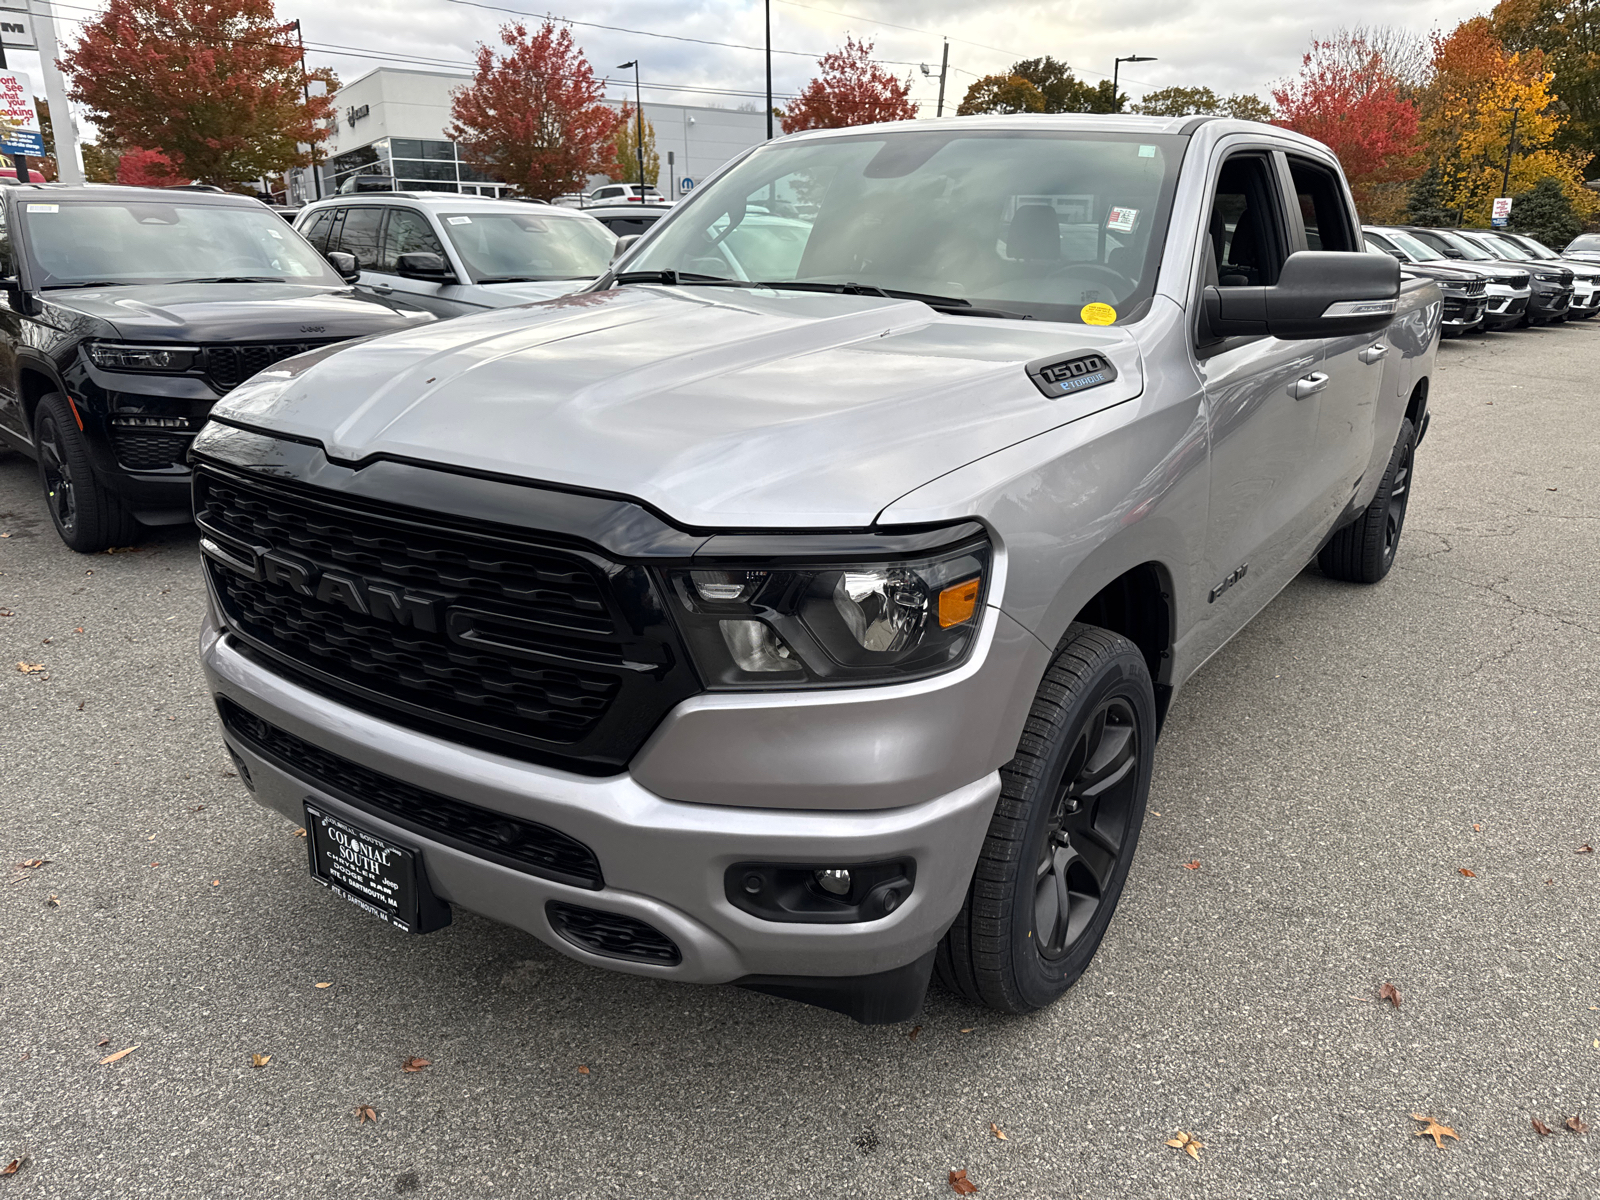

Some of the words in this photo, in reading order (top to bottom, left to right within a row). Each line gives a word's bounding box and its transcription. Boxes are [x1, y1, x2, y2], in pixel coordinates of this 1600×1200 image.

[0, 76, 17, 85] ont
[5, 84, 24, 92] see
[0, 107, 34, 118] ooking
[7, 99, 26, 108] your
[299, 325, 326, 333] Jeep
[1041, 357, 1102, 382] 1500
[264, 551, 445, 633] RAM
[1207, 562, 1249, 604] RAM
[326, 851, 376, 880] CHRYSLER
[381, 877, 399, 891] Jeep
[339, 844, 380, 875] SOUTH
[333, 862, 364, 883] DODGE
[369, 881, 392, 895] RAM
[348, 878, 387, 903] DARTMOUTH,
[387, 897, 398, 908] MA
[347, 894, 380, 918] DARTMOUTH,
[379, 912, 389, 922] MA
[393, 920, 409, 932] RAM
